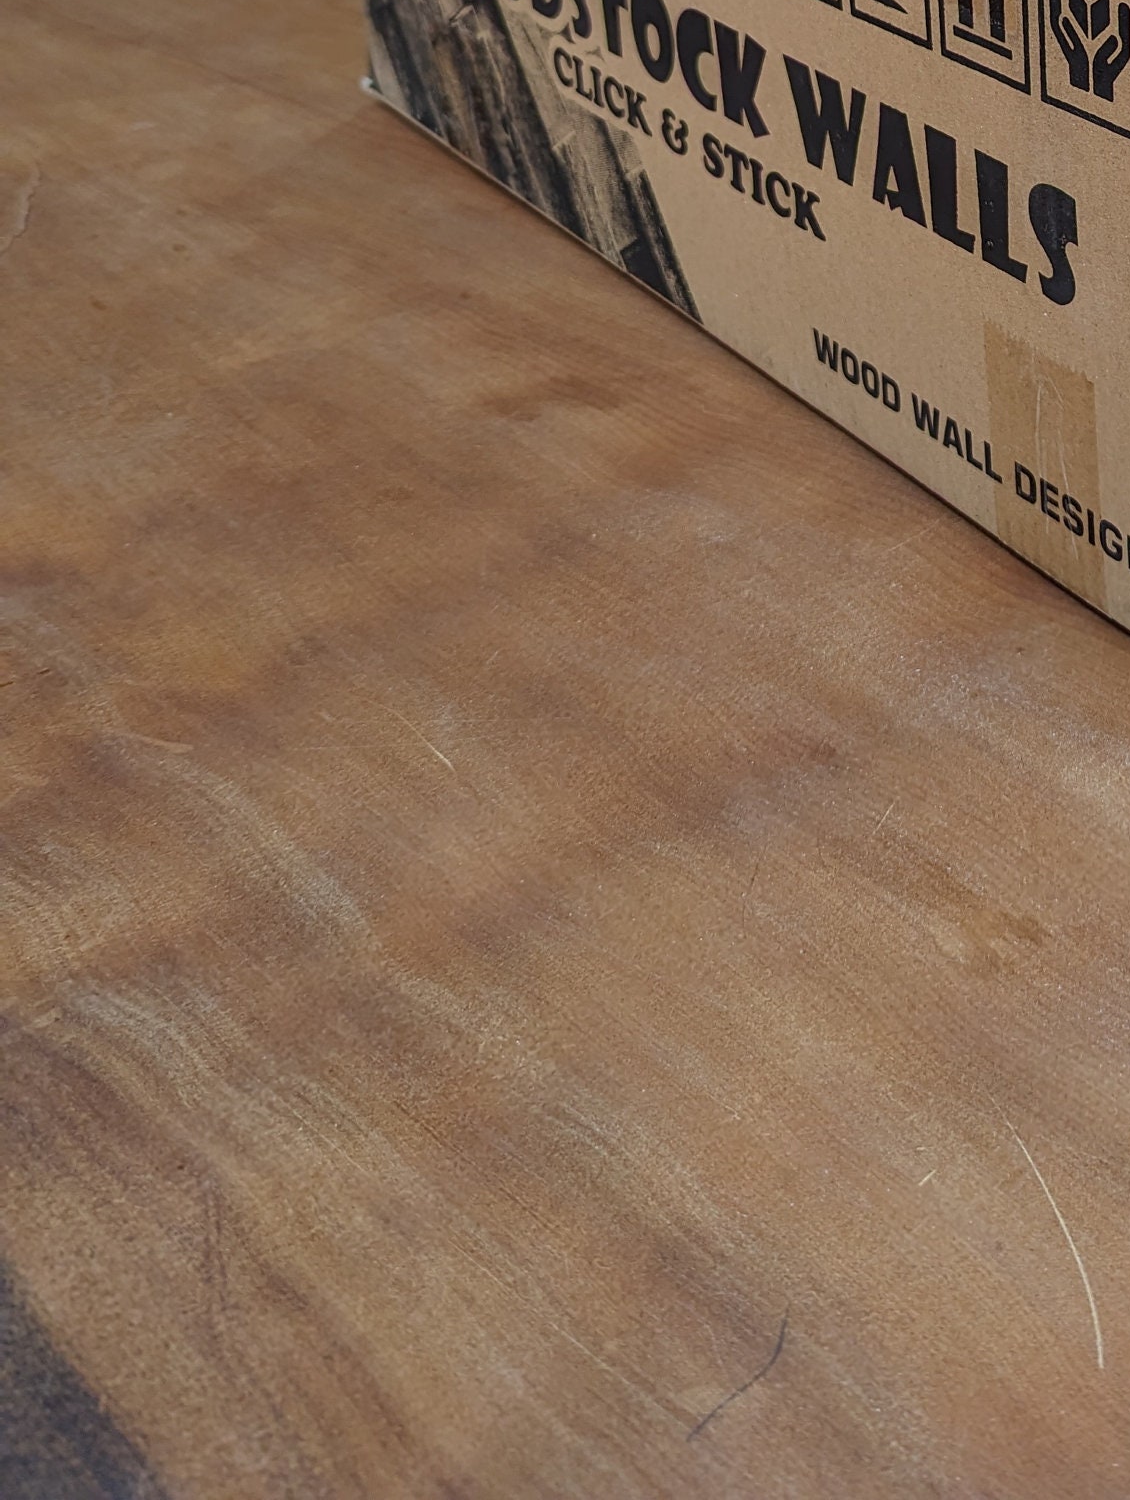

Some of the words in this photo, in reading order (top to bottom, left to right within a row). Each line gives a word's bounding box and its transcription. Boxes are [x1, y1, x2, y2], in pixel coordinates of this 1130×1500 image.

[553, 47, 654, 137] CLICK
[661, 108, 689, 156] &
[702, 132, 826, 242] STICK
[784, 54, 1078, 306] WALLS
[813, 328, 900, 413] WOOD
[912, 393, 1002, 483] WALL
